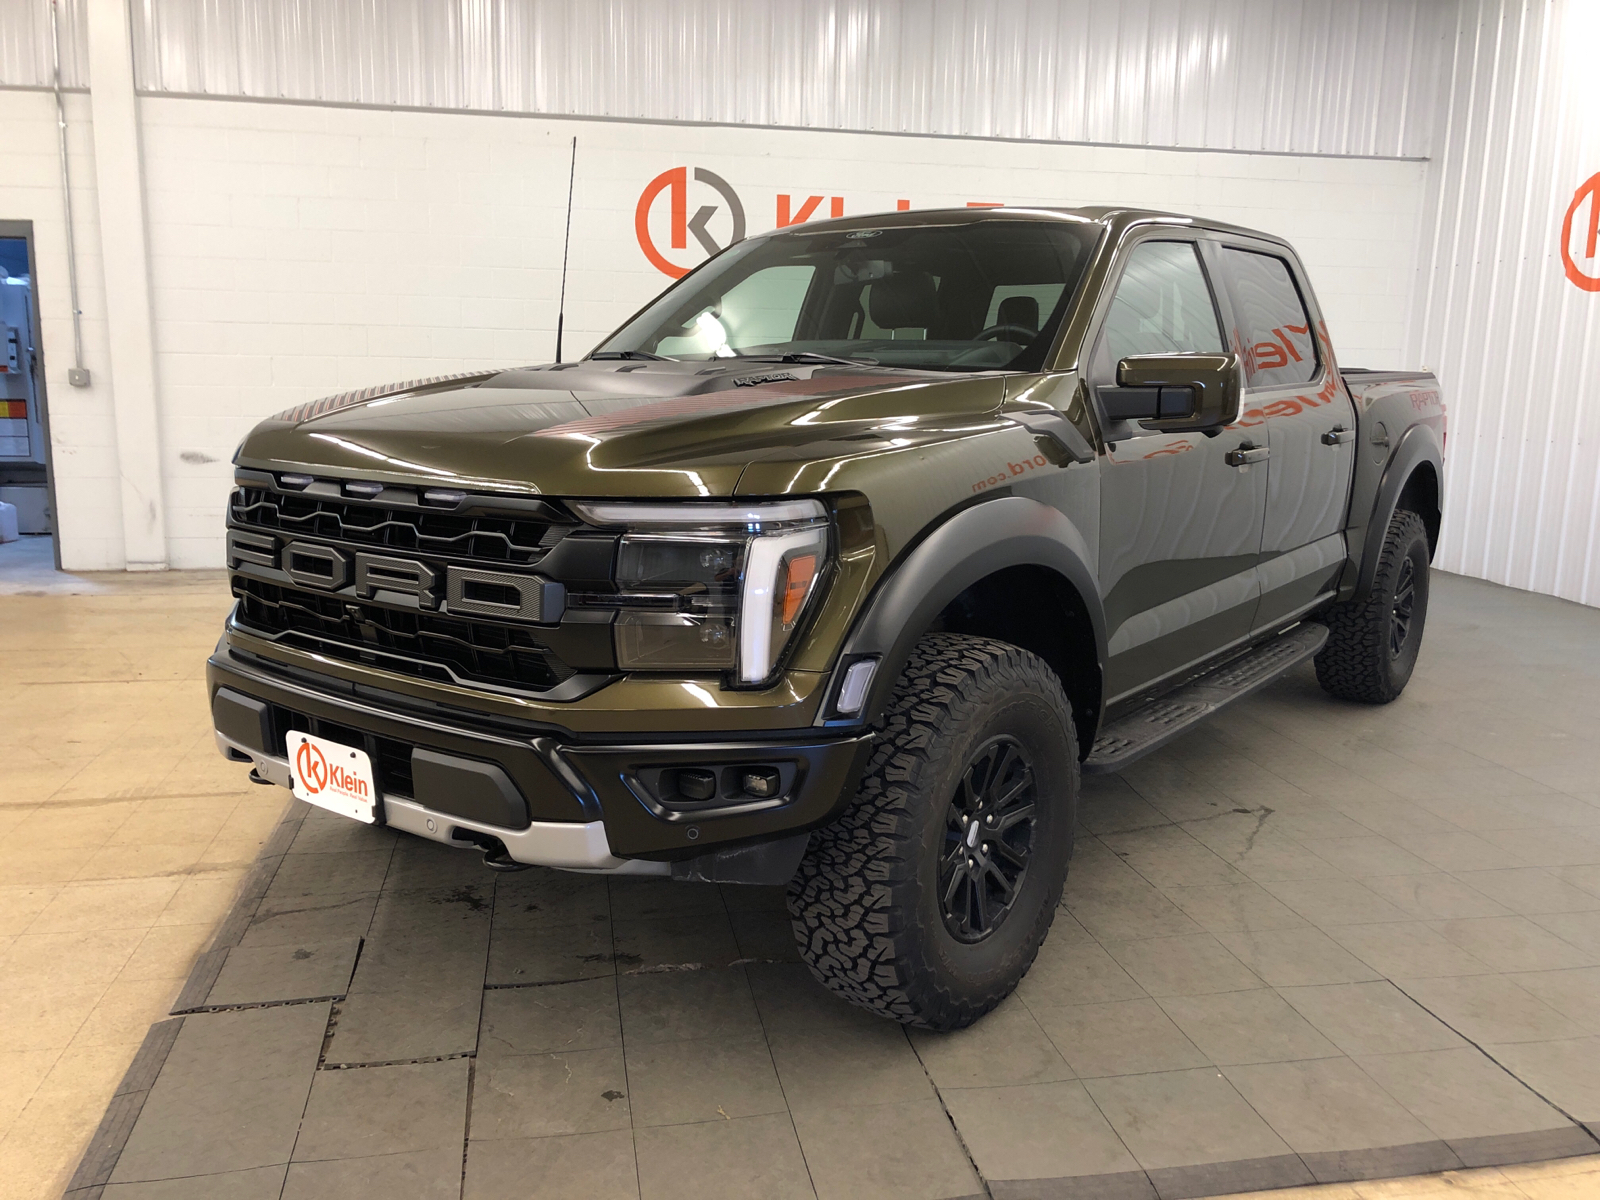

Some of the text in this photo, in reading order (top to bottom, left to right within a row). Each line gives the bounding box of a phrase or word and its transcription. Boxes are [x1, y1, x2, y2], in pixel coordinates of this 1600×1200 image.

[1409, 390, 1440, 411] RAPTO
[226, 528, 566, 629] FORD
[329, 763, 368, 797] Klein
